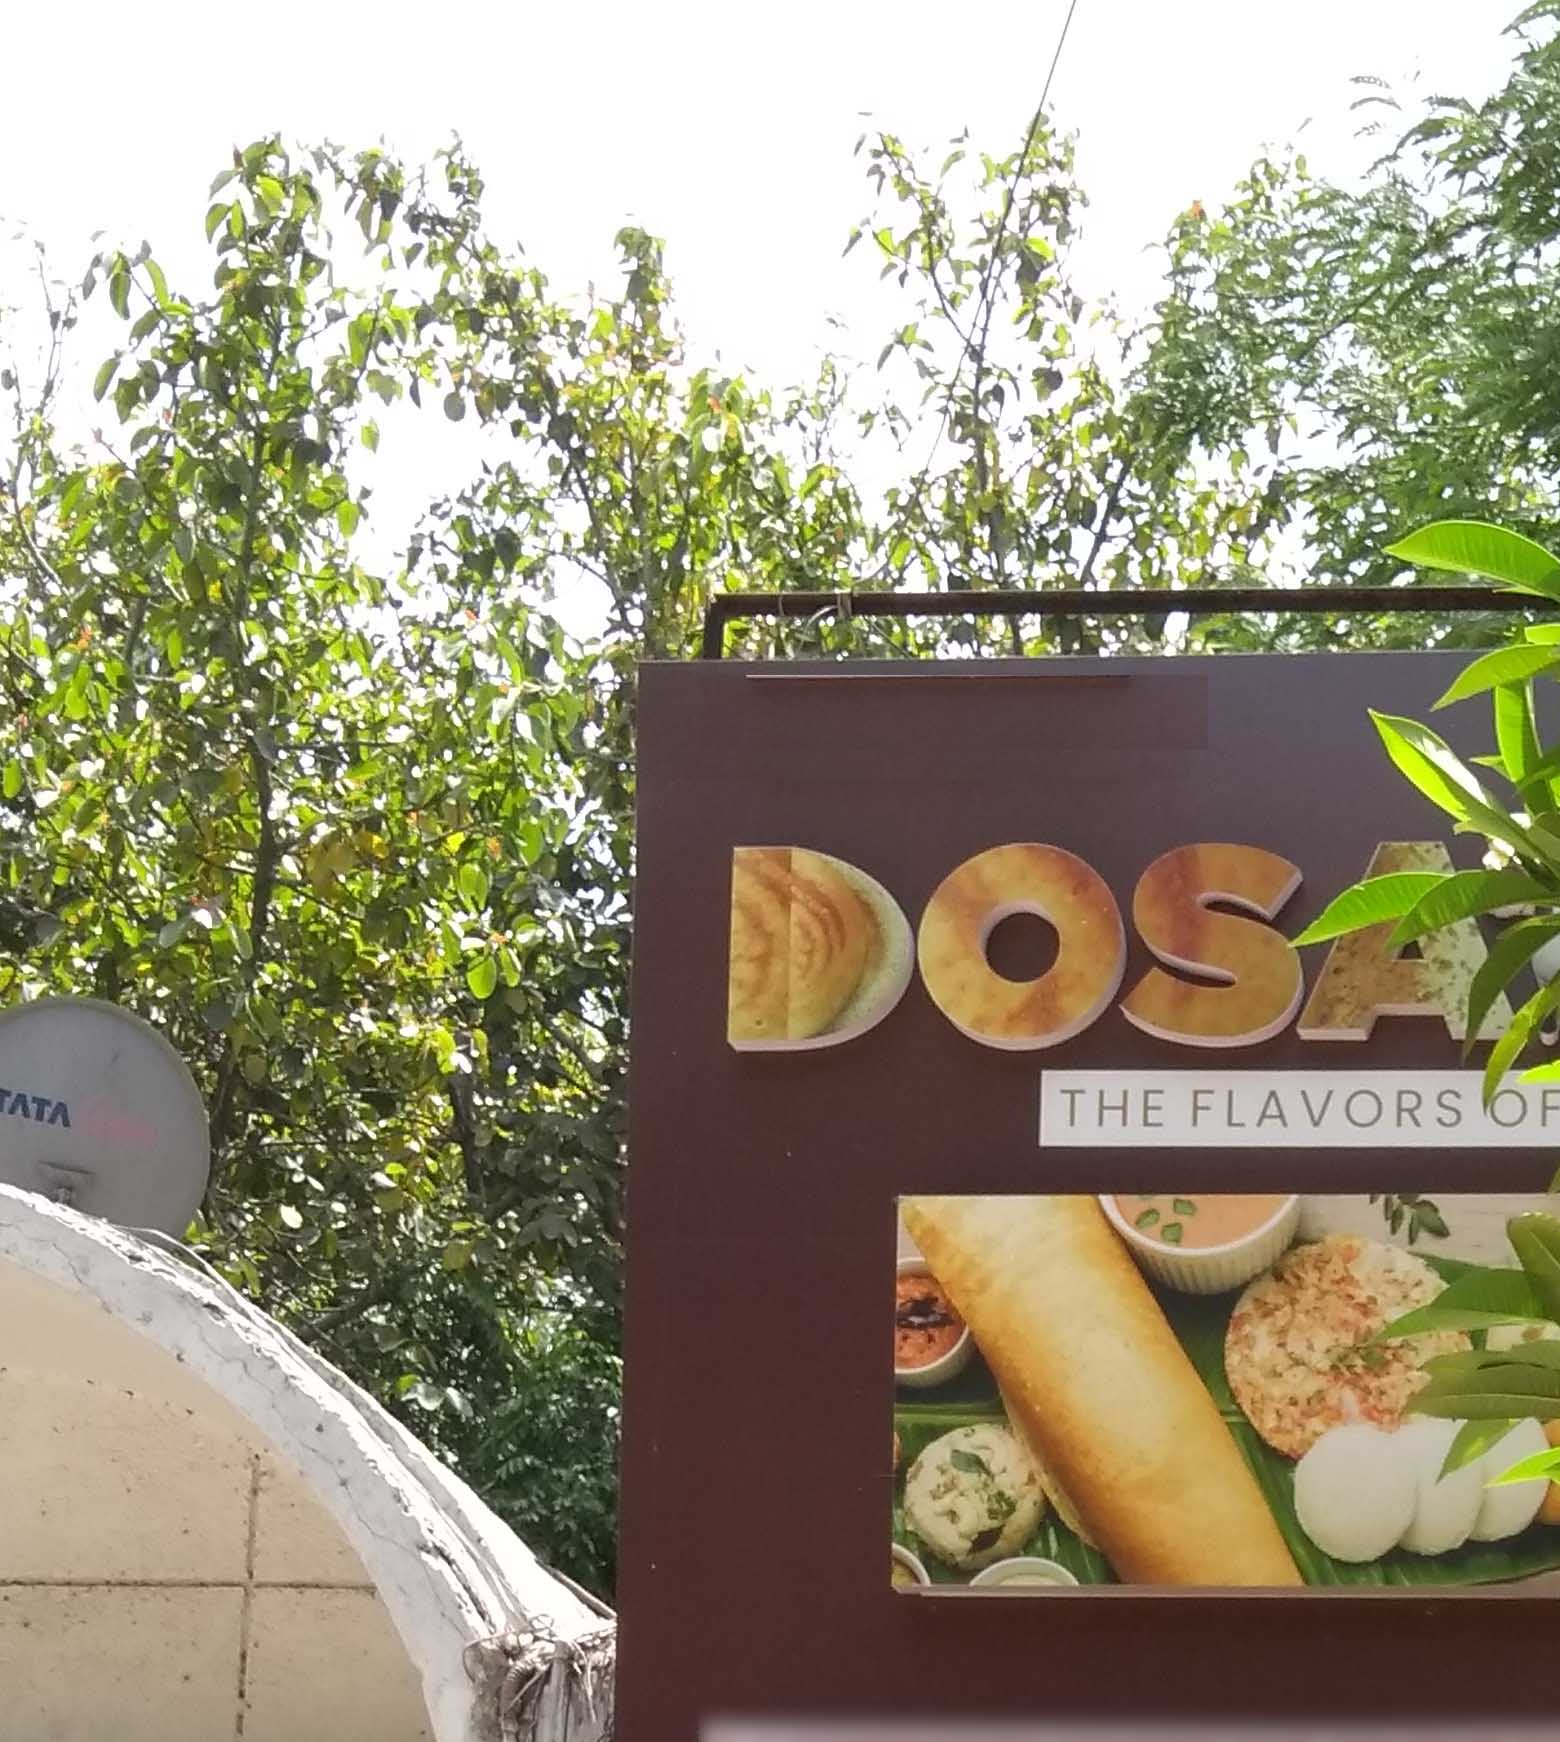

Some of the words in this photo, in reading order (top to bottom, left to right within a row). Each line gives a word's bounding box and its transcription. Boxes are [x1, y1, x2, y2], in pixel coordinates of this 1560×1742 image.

[727, 841, 1514, 1051] DOSA
[0, 1088, 71, 1128] TATA
[1059, 1088, 1165, 1128] THE
[1191, 1088, 1463, 1129] FLAVORS
